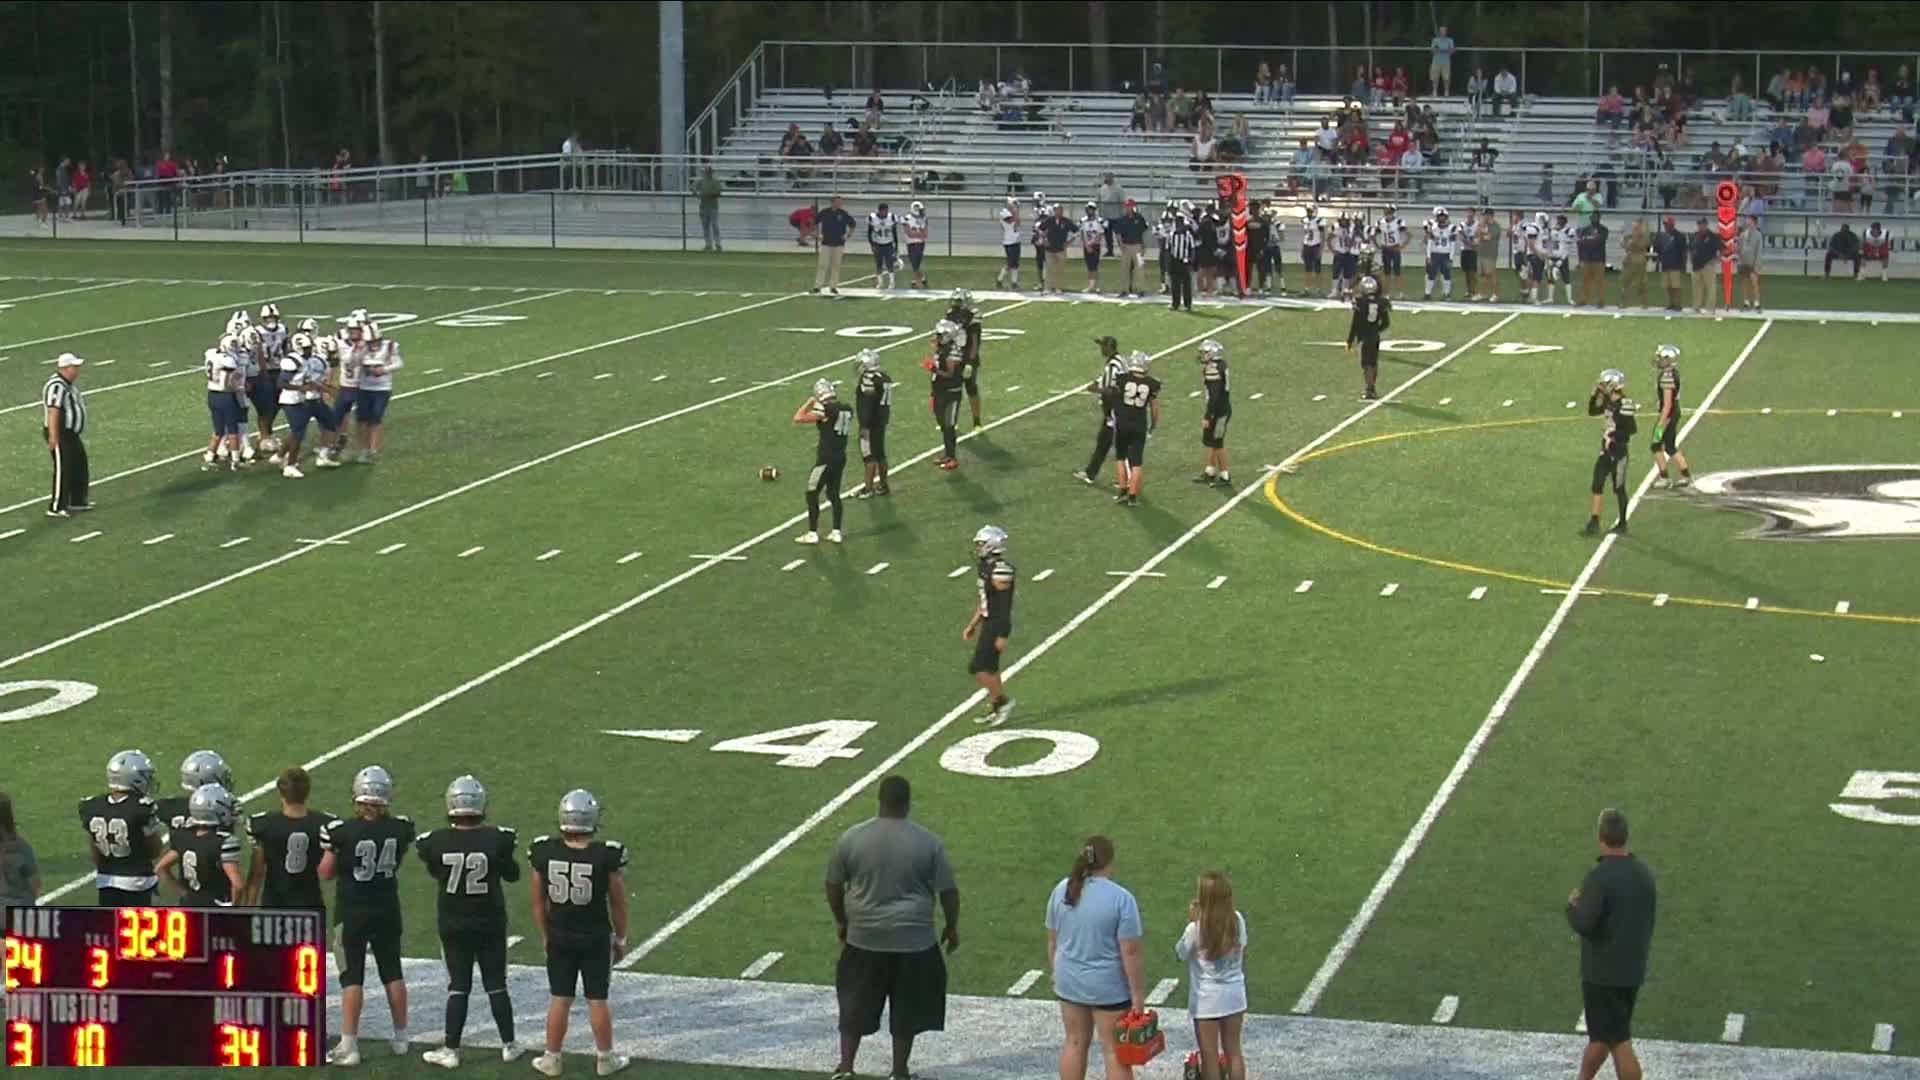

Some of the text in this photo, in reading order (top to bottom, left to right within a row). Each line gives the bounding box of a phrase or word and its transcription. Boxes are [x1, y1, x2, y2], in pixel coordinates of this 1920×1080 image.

[1124, 381, 1150, 408] 23
[89, 816, 132, 858] 33
[285, 832, 310, 874] 8
[353, 838, 398, 882] 34
[442, 852, 488, 895] 72
[548, 859, 593, 905] 55
